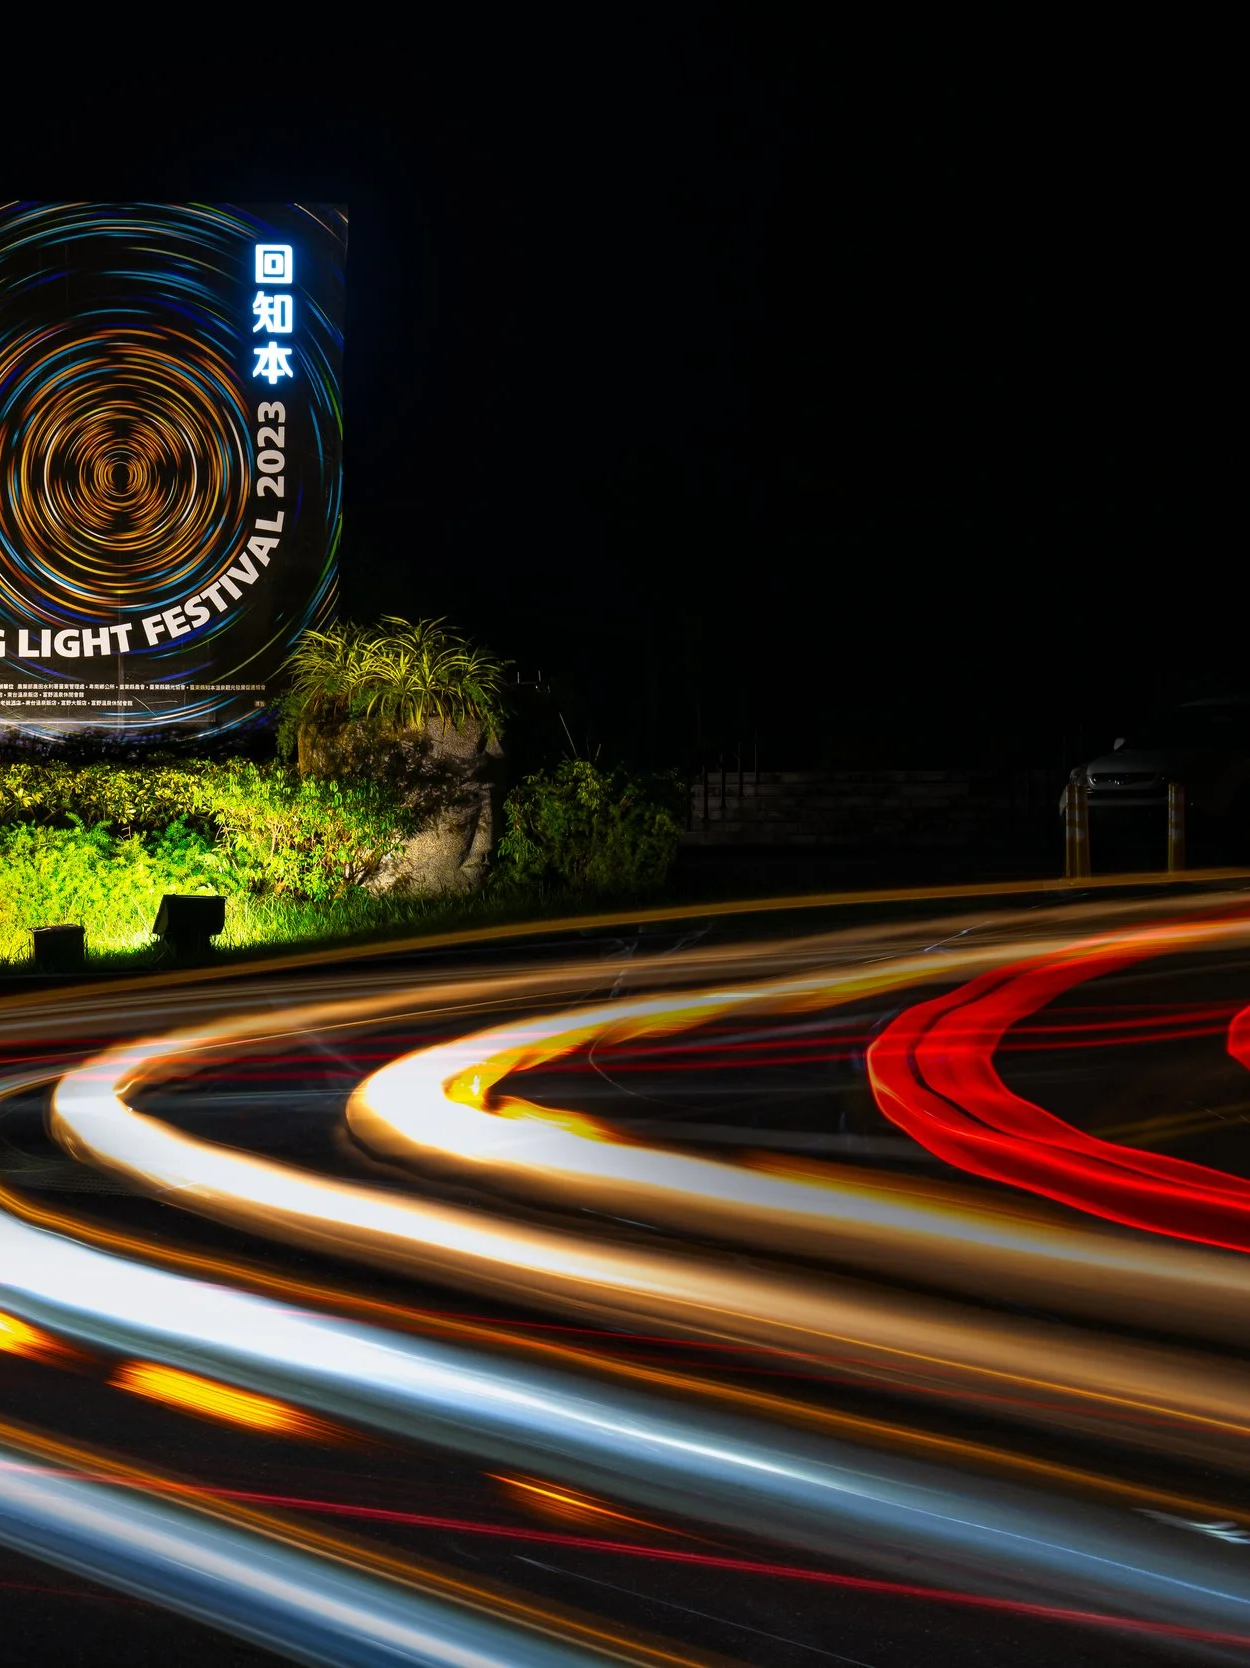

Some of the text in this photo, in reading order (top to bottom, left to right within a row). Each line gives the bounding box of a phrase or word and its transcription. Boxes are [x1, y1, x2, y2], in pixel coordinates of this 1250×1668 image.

[253, 244, 293, 385] 回知本
[18, 622, 133, 658] LIGHT
[142, 510, 285, 647] FESTIVAL
[256, 401, 286, 498] 2023
